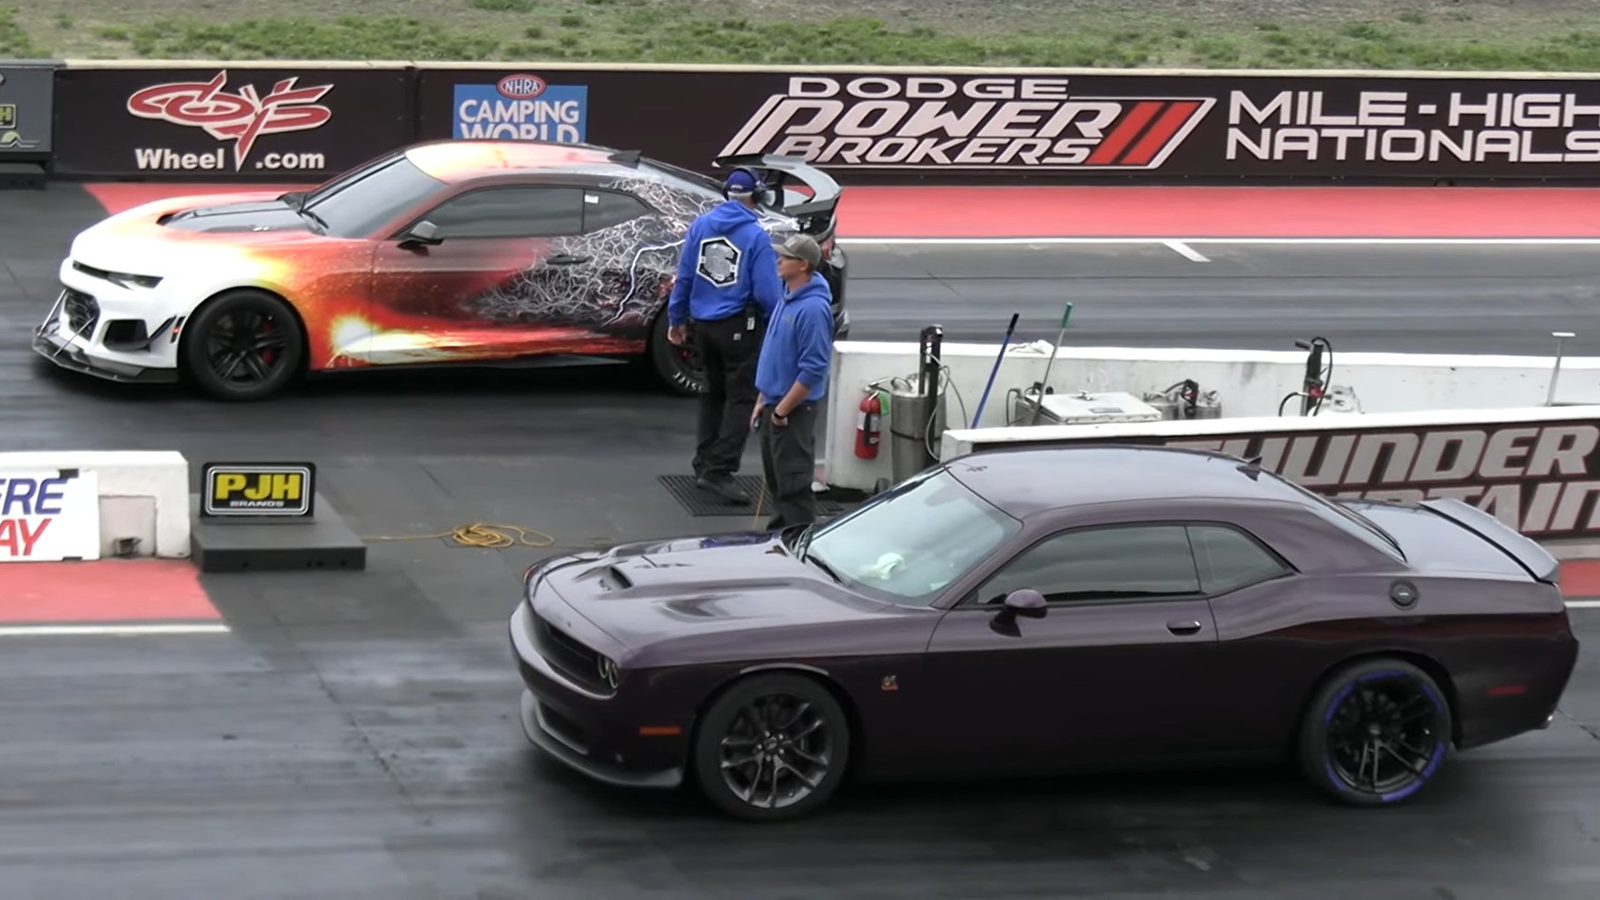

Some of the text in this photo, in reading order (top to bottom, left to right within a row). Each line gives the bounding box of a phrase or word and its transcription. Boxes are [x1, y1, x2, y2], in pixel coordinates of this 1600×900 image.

[505, 79, 540, 95] NHRA
[788, 77, 1069, 99] DODGE
[459, 99, 580, 124] CAMPING
[735, 99, 1122, 153] POWER
[773, 135, 1102, 165] BROKERS
[1226, 128, 1600, 162] NATIONALS
[135, 148, 325, 169] Wheel .com
[0, 478, 69, 515] RE
[215, 474, 301, 500] PJH
